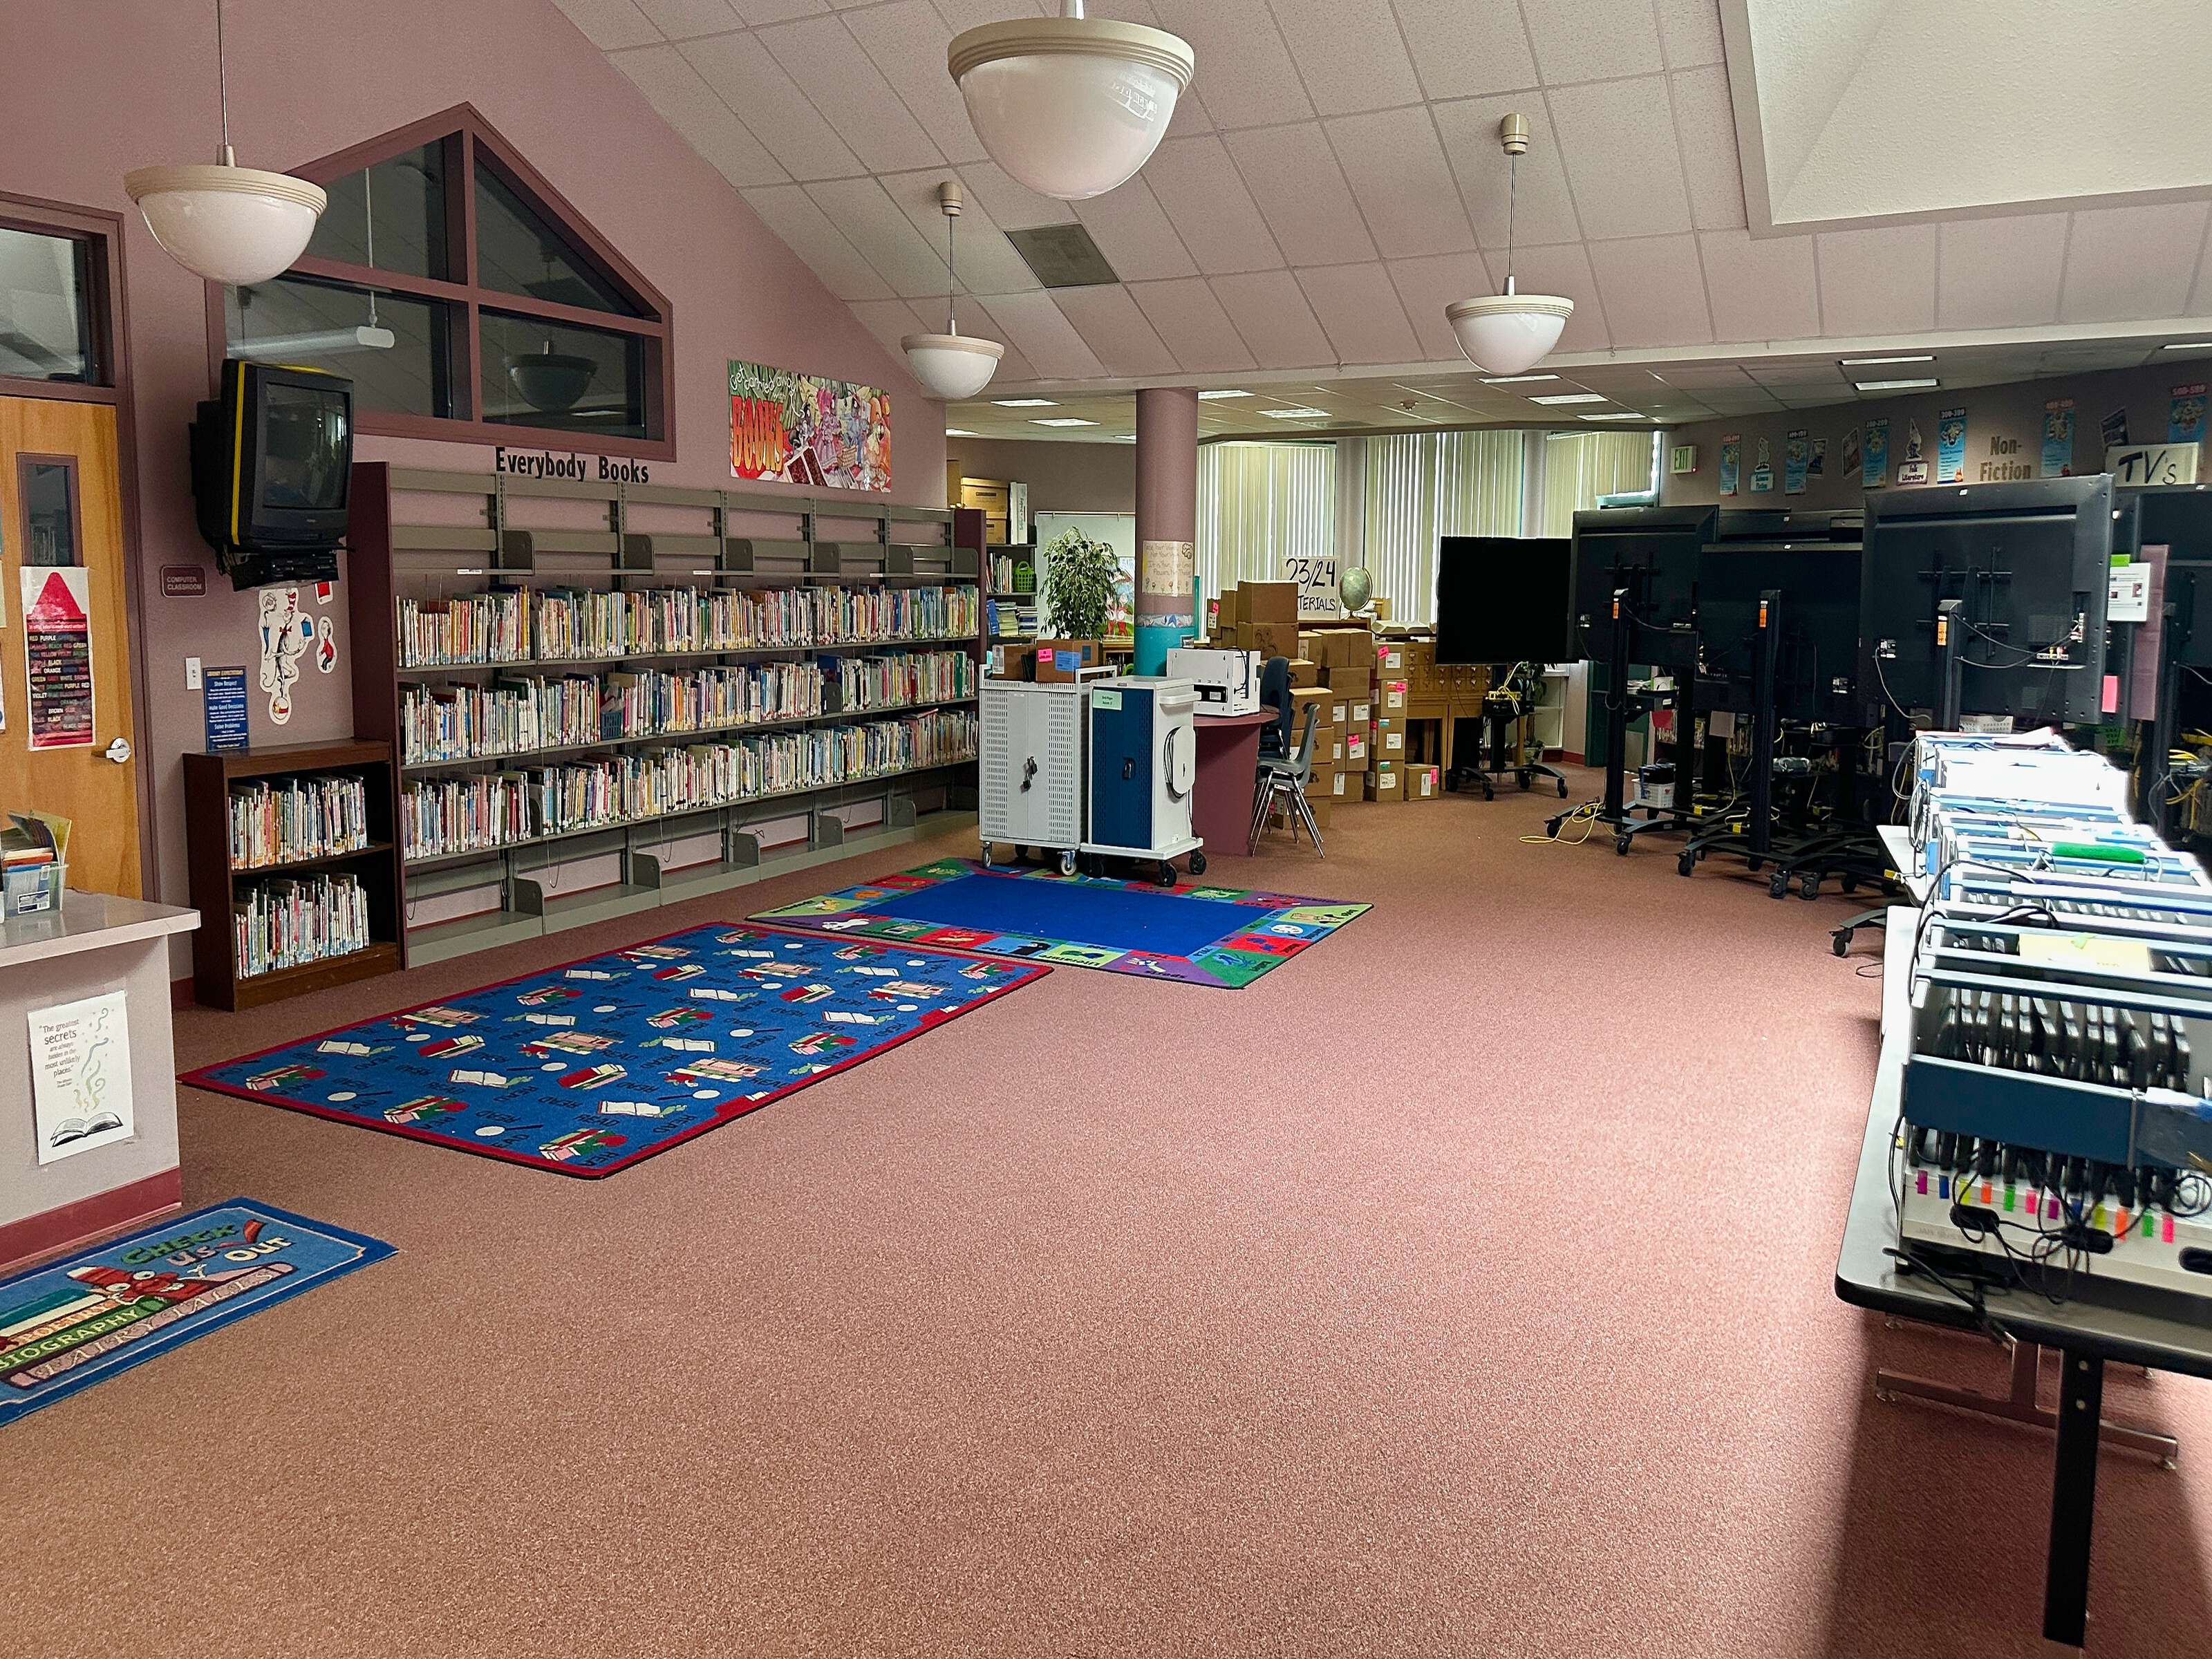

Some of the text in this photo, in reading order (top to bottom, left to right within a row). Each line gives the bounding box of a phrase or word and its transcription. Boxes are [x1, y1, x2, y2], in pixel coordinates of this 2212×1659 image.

[730, 365, 745, 391] Get
[744, 375, 799, 397] carried away
[772, 391, 787, 400] with
[731, 395, 784, 473] BOOKS
[1990, 436, 2022, 456] Non-
[495, 447, 650, 484] Everybody Books
[1674, 448, 1689, 471] EXIT
[1979, 460, 2032, 482] Fiction
[2118, 450, 2177, 485] TV's
[1286, 558, 1335, 593] 23/24
[44, 1030, 77, 1044] secrets
[45, 1061, 58, 1069] most
[121, 1224, 239, 1264] CHECK
[19, 1300, 117, 1344] POETRY
[39, 1269, 273, 1378] FAIRY TALES
